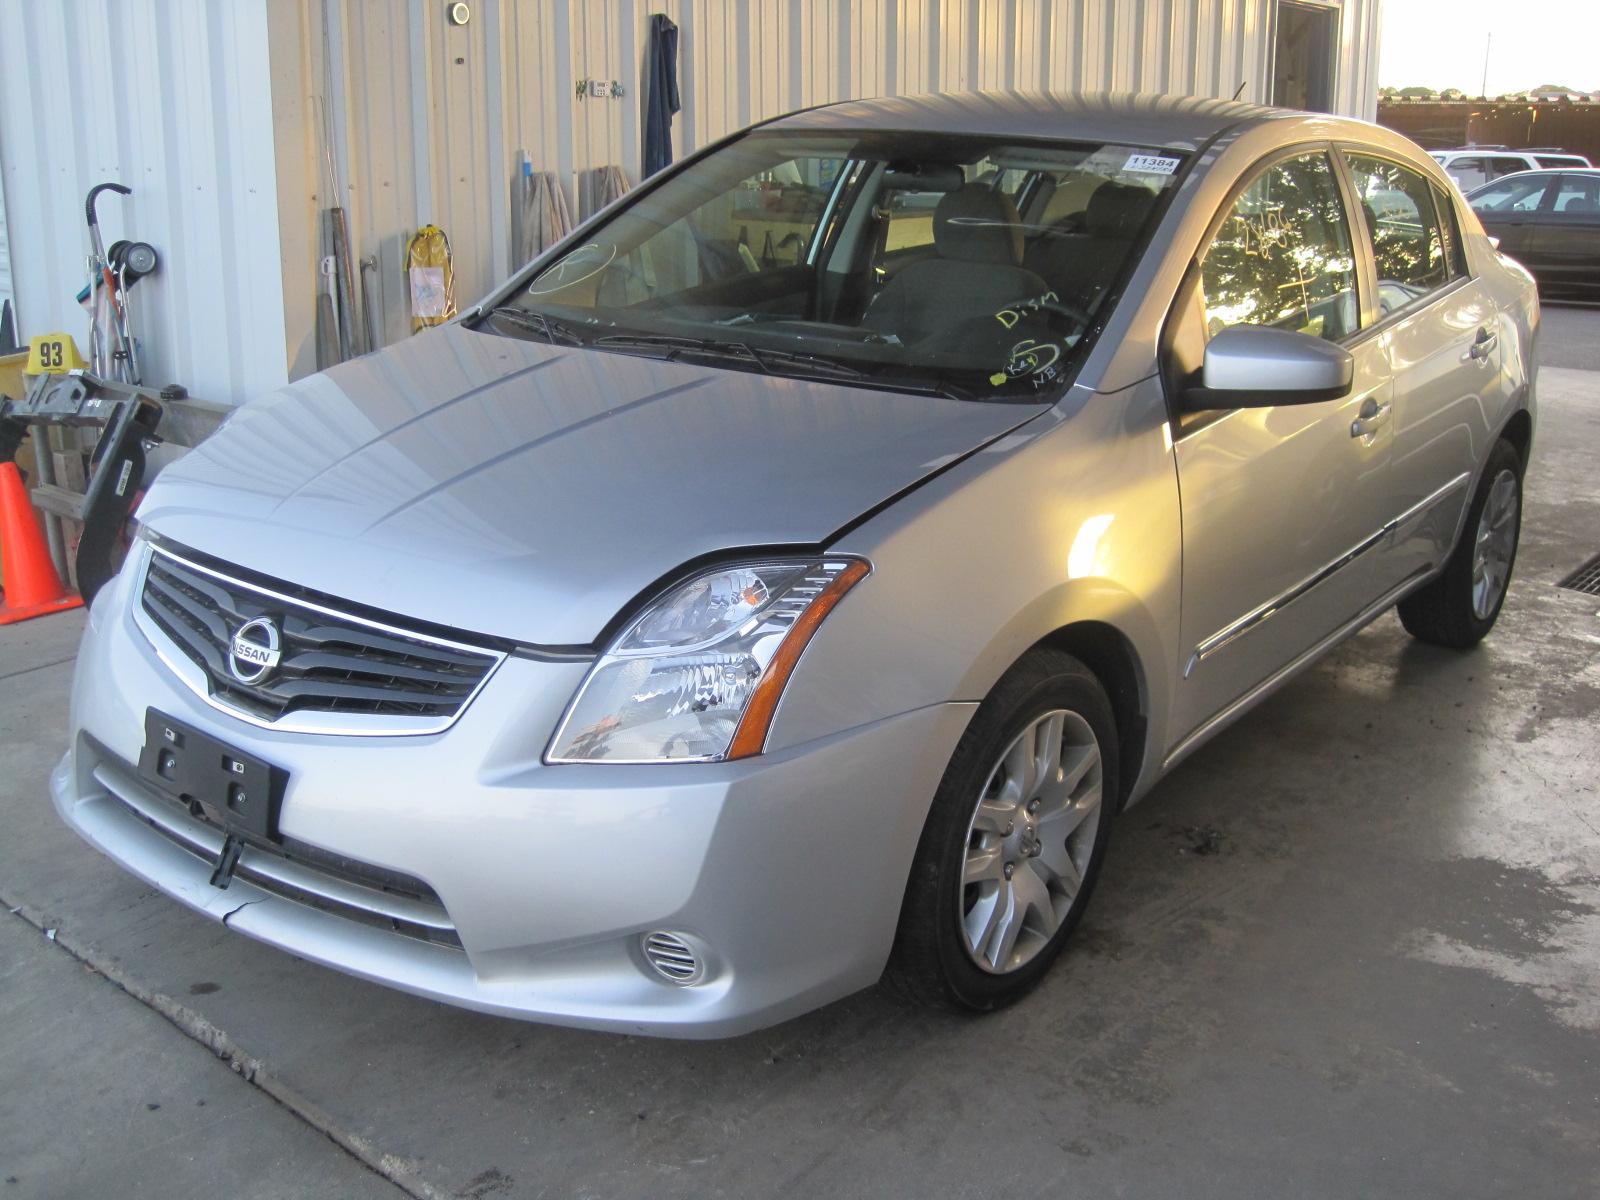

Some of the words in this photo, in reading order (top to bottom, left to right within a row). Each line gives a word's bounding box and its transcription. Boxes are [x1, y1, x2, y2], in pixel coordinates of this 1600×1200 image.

[1133, 157, 1175, 167] 11384
[40, 341, 63, 367] 93
[232, 641, 271, 663] NISSAN
